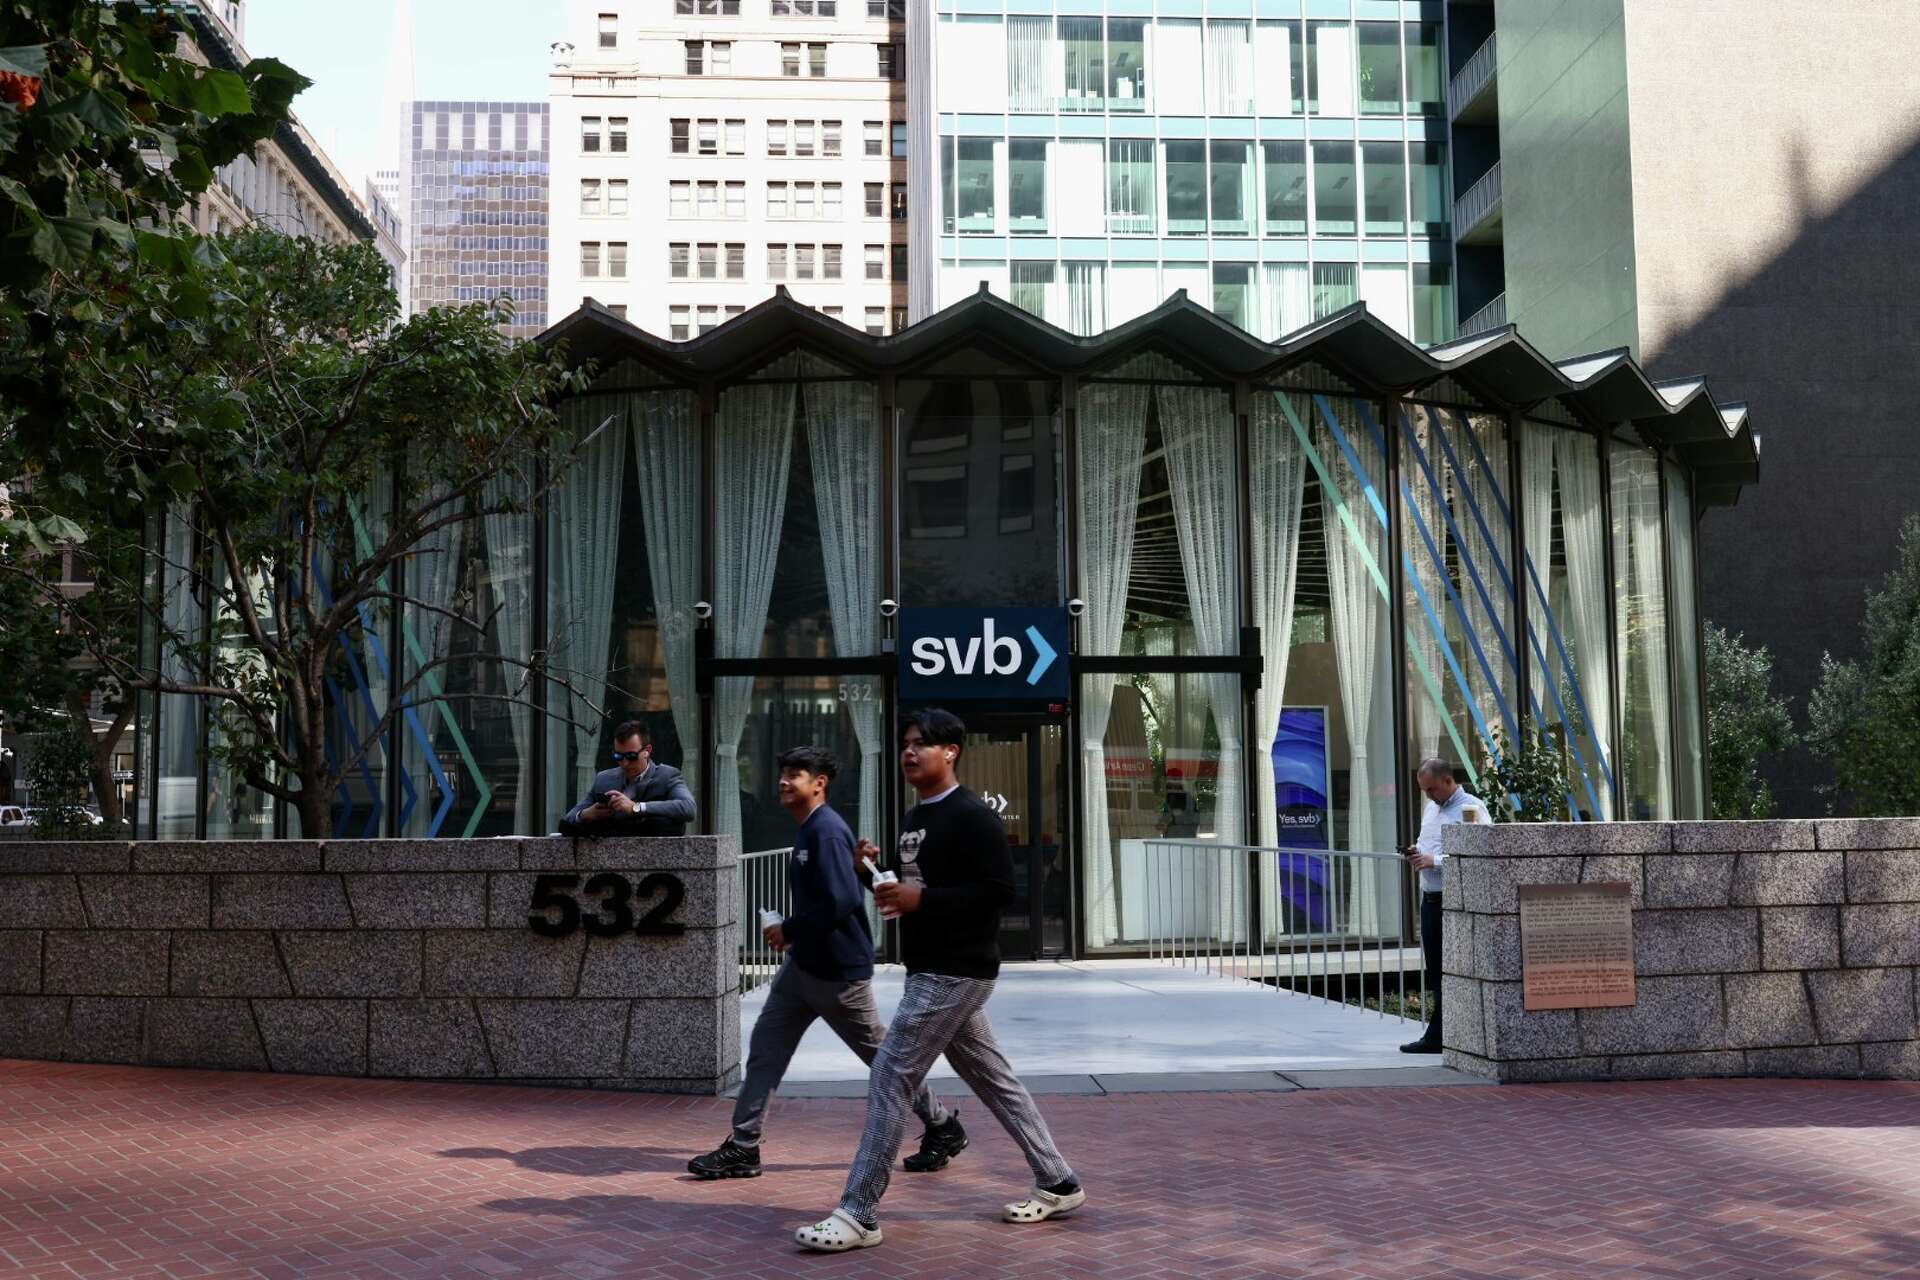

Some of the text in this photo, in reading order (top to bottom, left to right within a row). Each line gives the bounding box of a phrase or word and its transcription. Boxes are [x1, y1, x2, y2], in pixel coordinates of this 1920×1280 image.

[911, 618, 1023, 676] svb
[839, 683, 873, 702] 532
[1299, 812, 1315, 824] svb
[528, 872, 686, 937] 532
